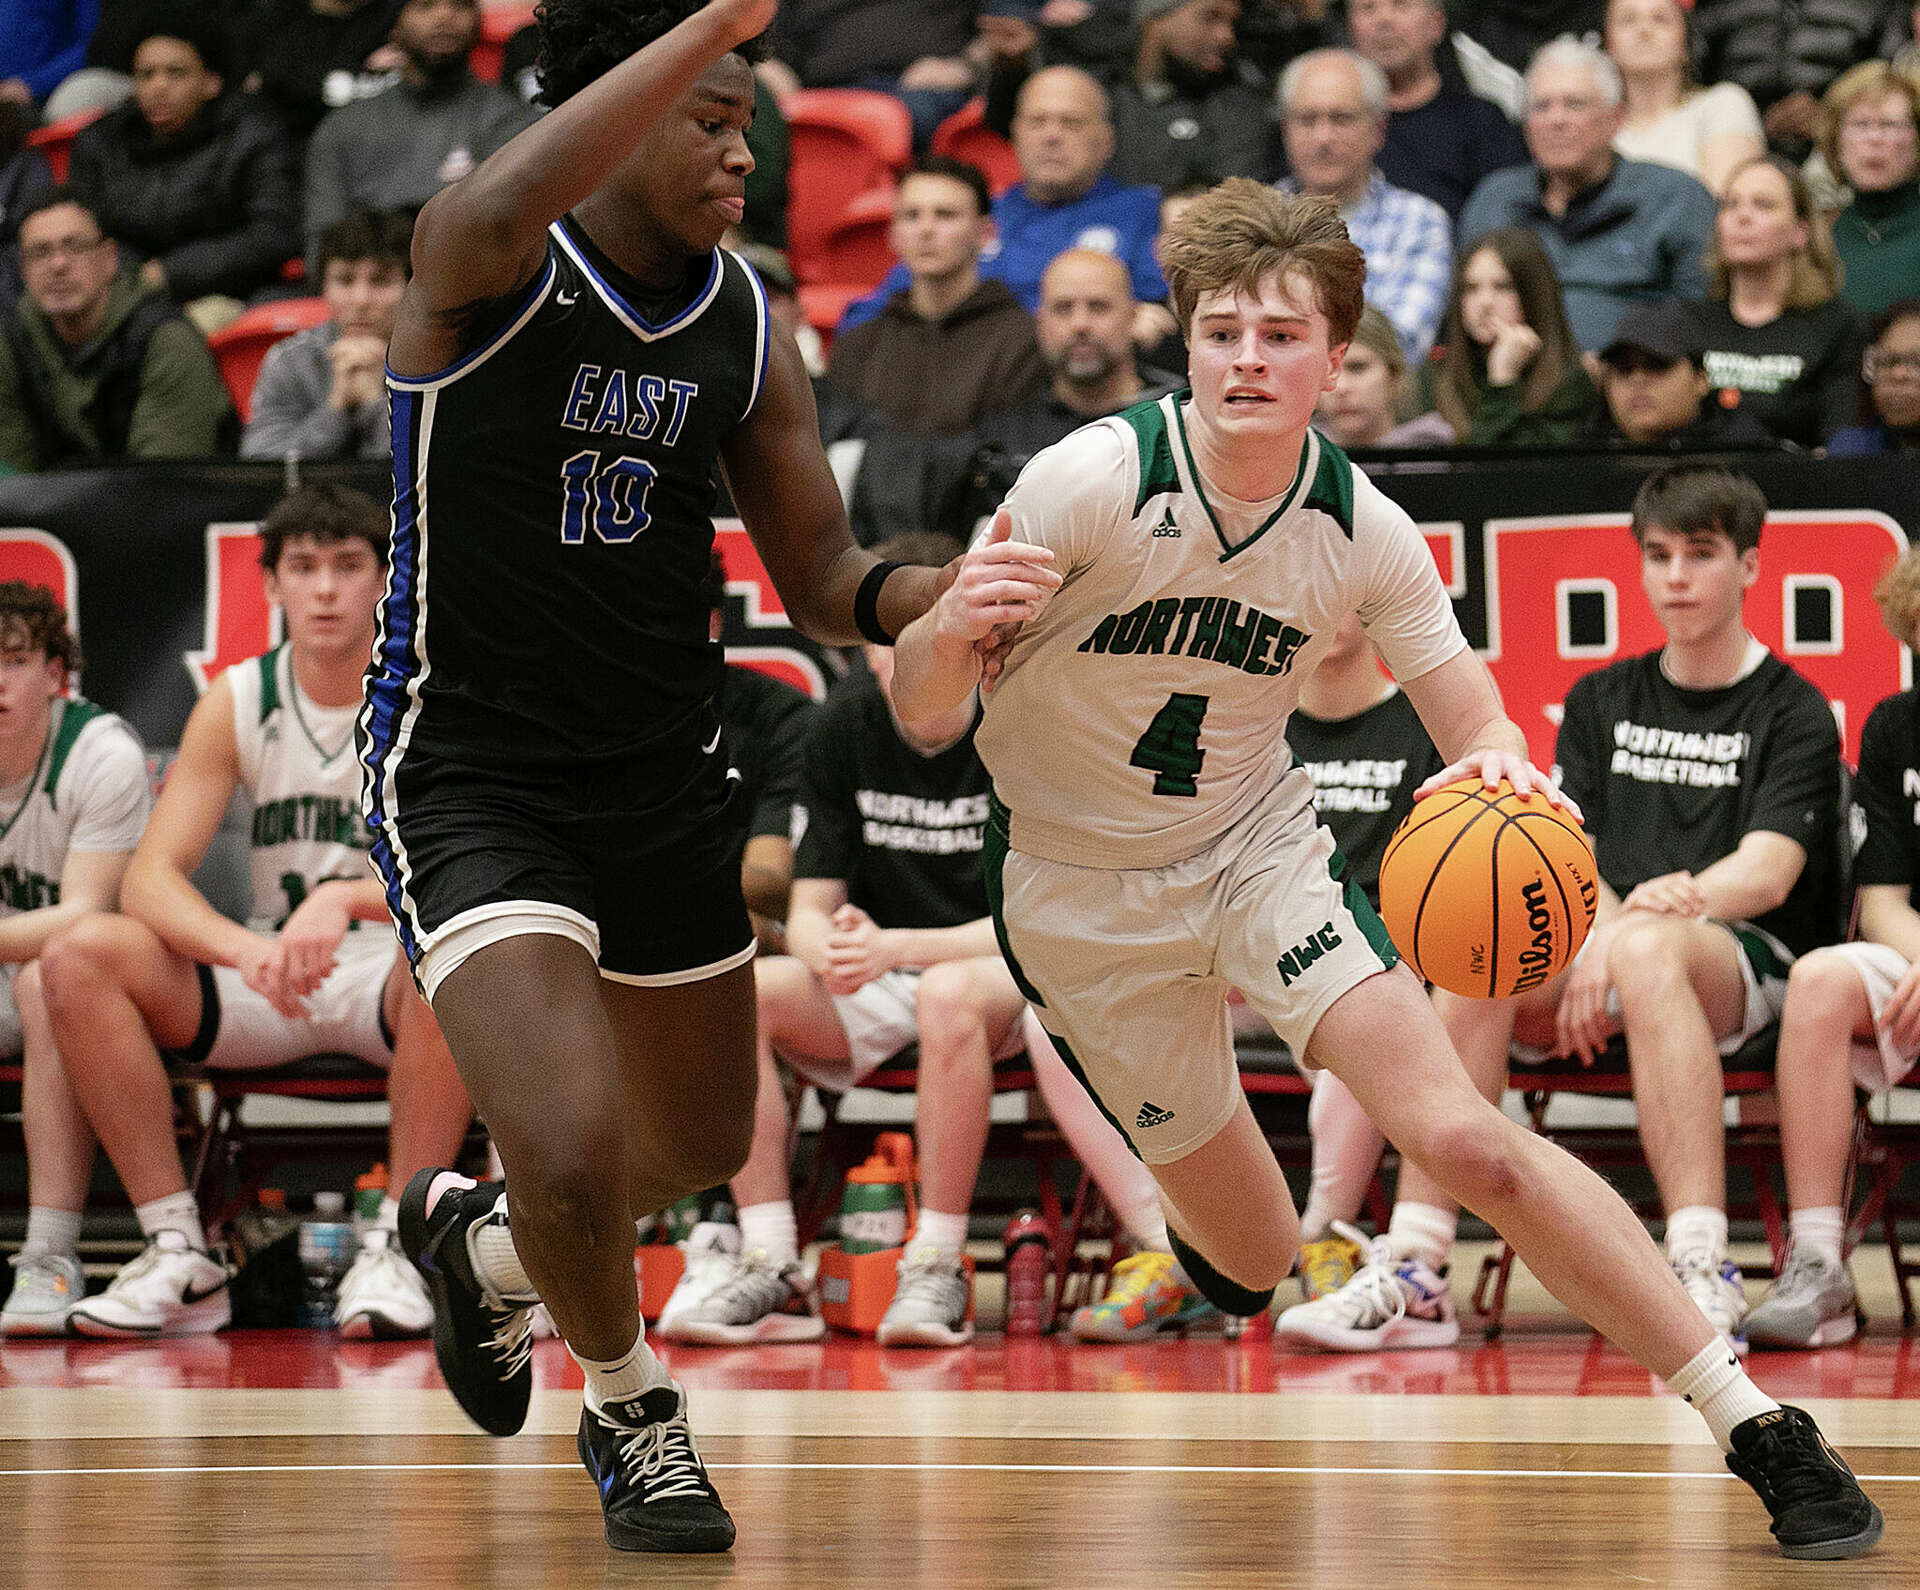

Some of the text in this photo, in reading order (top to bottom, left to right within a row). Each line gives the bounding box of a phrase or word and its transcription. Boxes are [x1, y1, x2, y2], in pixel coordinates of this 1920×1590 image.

[561, 364, 698, 447] EAST
[561, 450, 658, 544] 10
[1077, 597, 1313, 676] NORTHWEST
[1129, 692, 1210, 797] 4
[1304, 760, 1407, 788] THWEST
[855, 790, 990, 828] NORTHWES
[1277, 921, 1342, 988] NWC
[1510, 877, 1553, 996] Wilson
[1136, 1111, 1175, 1128] adidas
